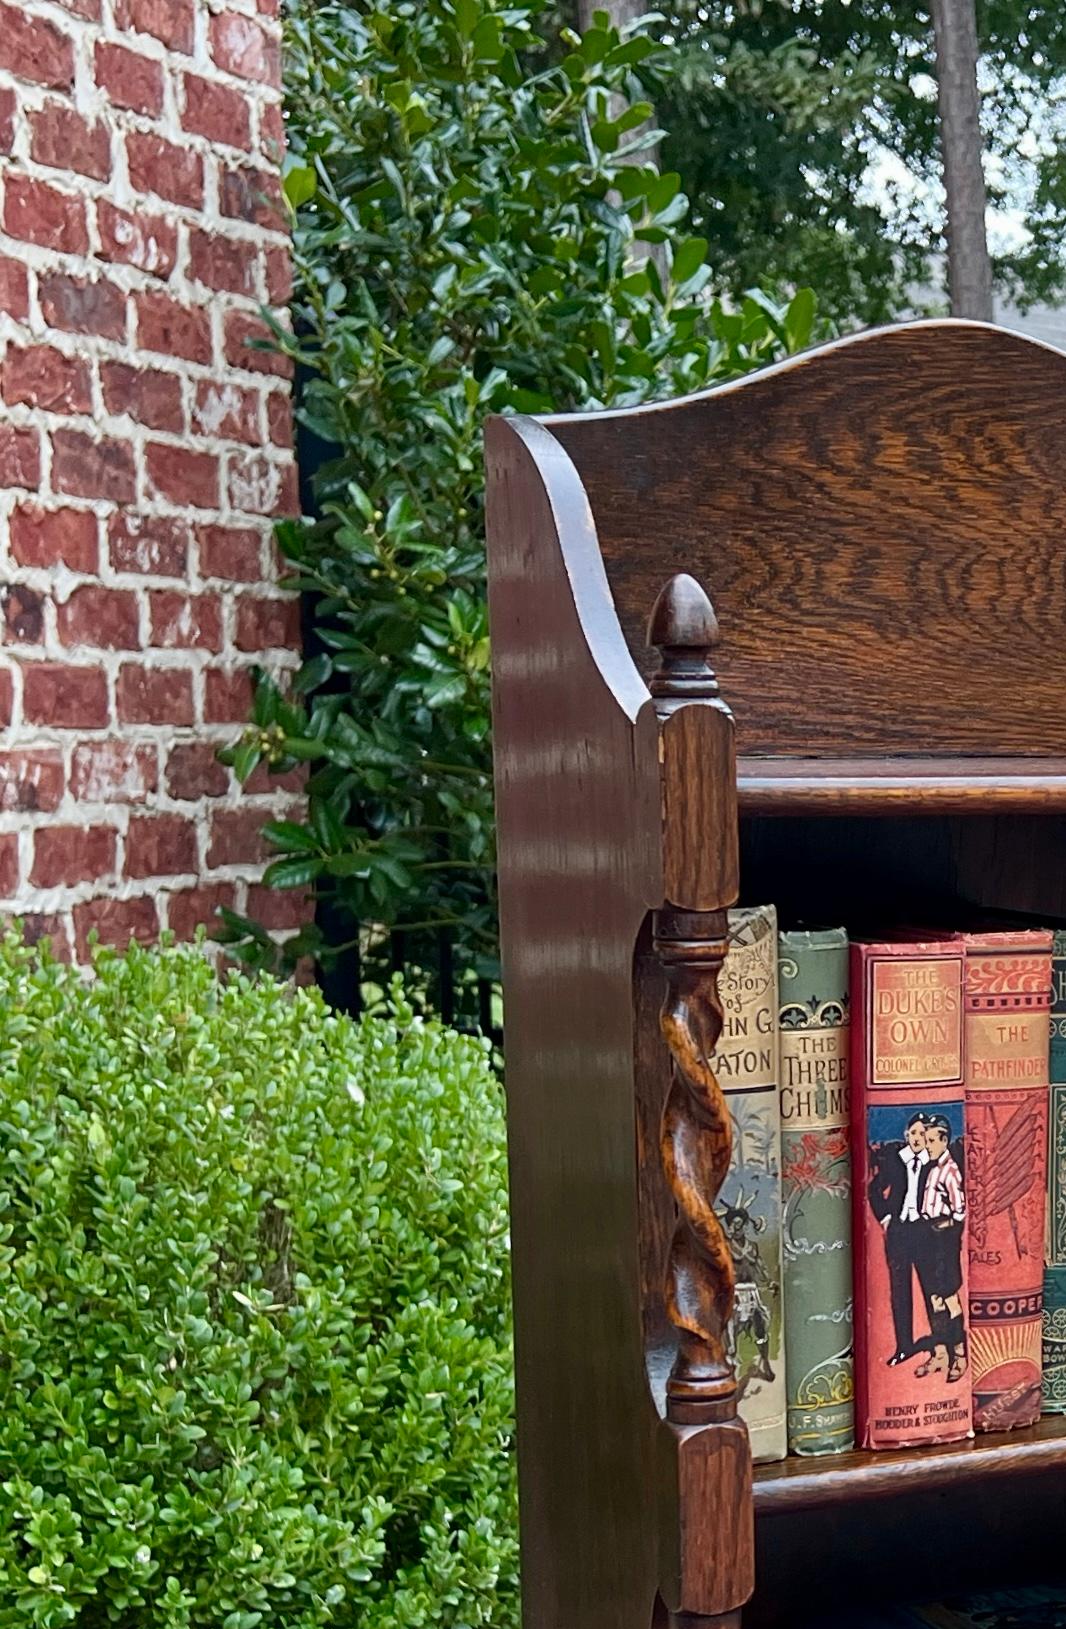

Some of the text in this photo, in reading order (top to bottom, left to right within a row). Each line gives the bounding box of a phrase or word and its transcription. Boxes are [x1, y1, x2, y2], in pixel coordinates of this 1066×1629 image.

[726, 971, 770, 996] Story
[903, 970, 937, 986] THE
[726, 993, 743, 1014] of
[878, 986, 957, 1015] DUKE'S
[889, 1019, 948, 1044] OWN
[996, 1025, 1029, 1043] THE
[799, 1036, 837, 1054] THE
[784, 1056, 847, 1086] THREE
[875, 1058, 919, 1073] COLONEL
[971, 1057, 1047, 1079] PATHFINDER
[968, 1250, 1001, 1265] TALES
[885, 1398, 960, 1417] HENRY FROWDE
[923, 1408, 969, 1427] STOUGHTON
